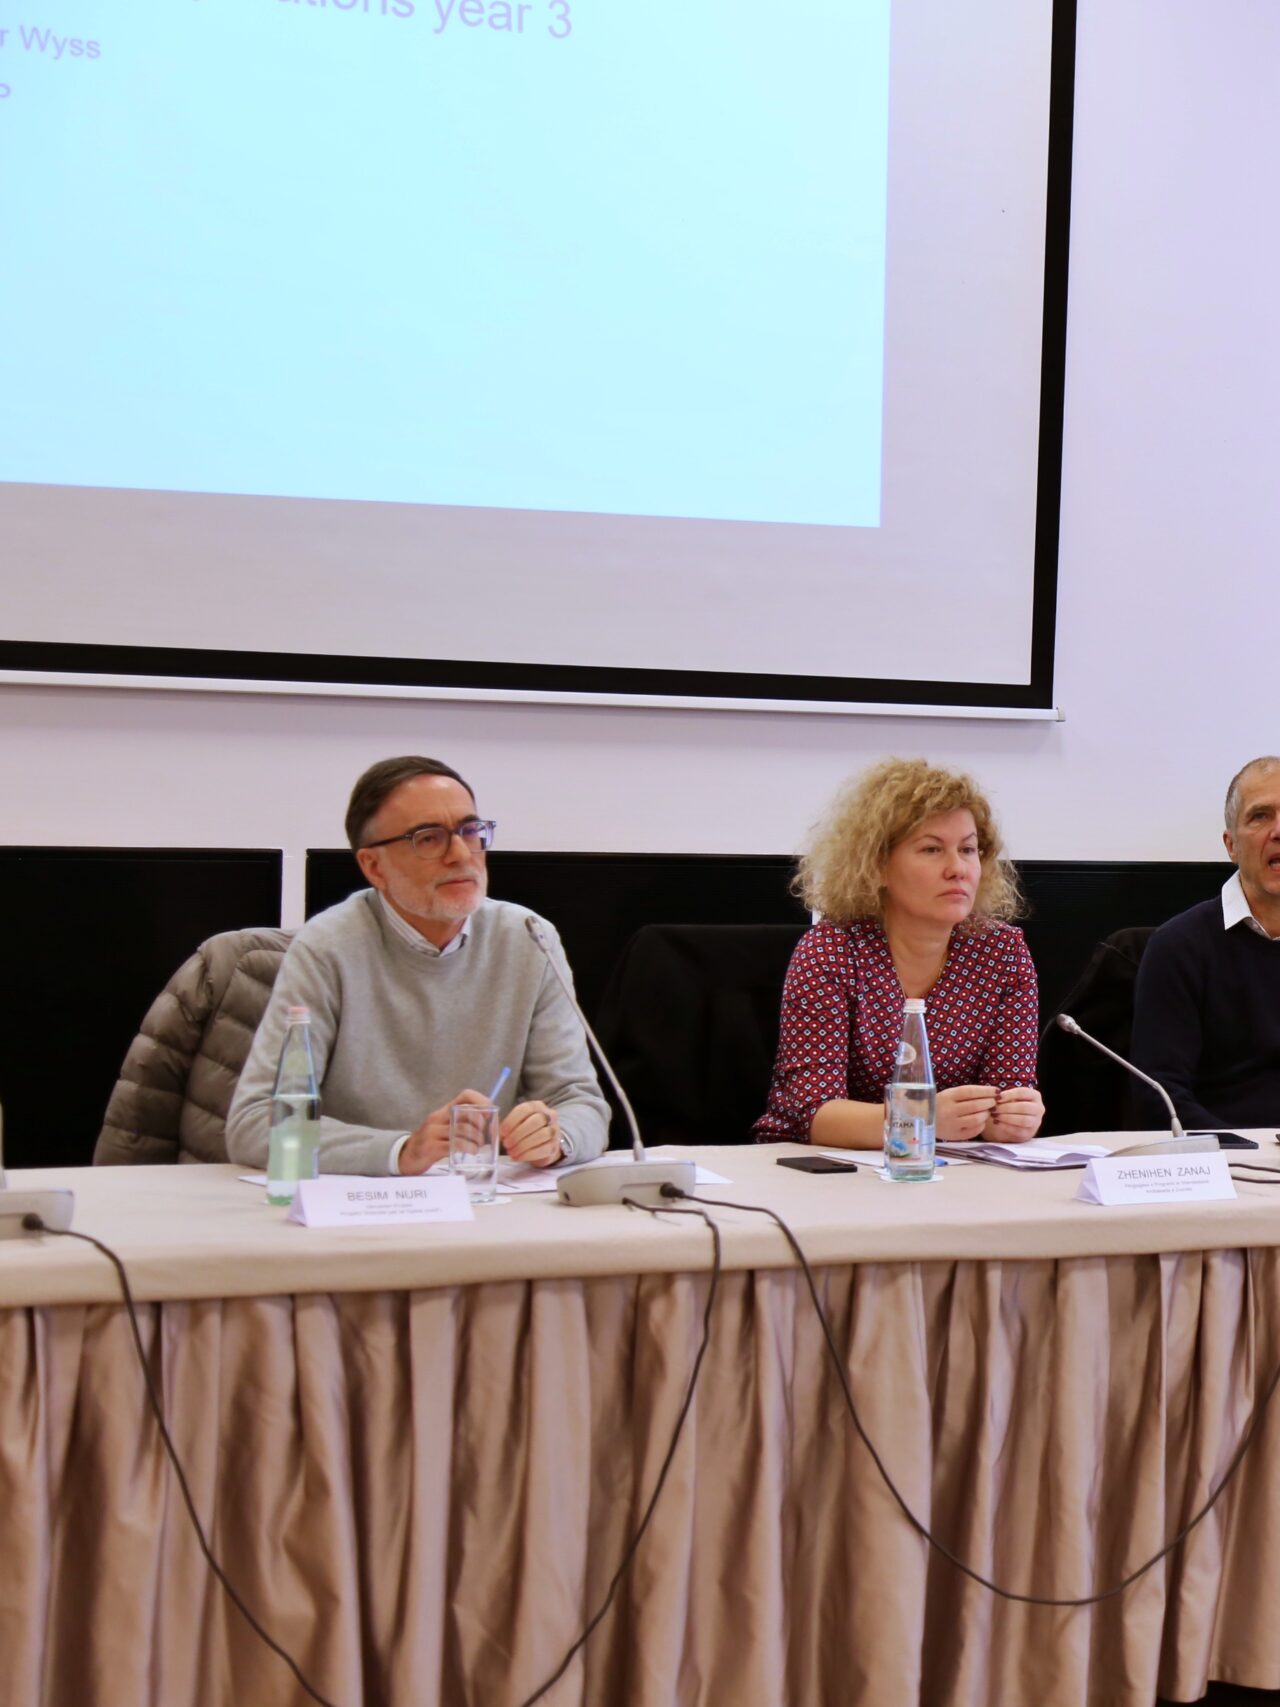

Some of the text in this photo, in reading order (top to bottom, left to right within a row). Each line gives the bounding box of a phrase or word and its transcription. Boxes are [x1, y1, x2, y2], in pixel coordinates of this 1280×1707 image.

[433, 0, 533, 34] year
[547, 0, 573, 39] 3
[19, 24, 101, 61] Wyss
[1117, 1166, 1211, 1180] ZHENIHEN ZANAJ
[347, 1189, 427, 1201] BESIM NURI
